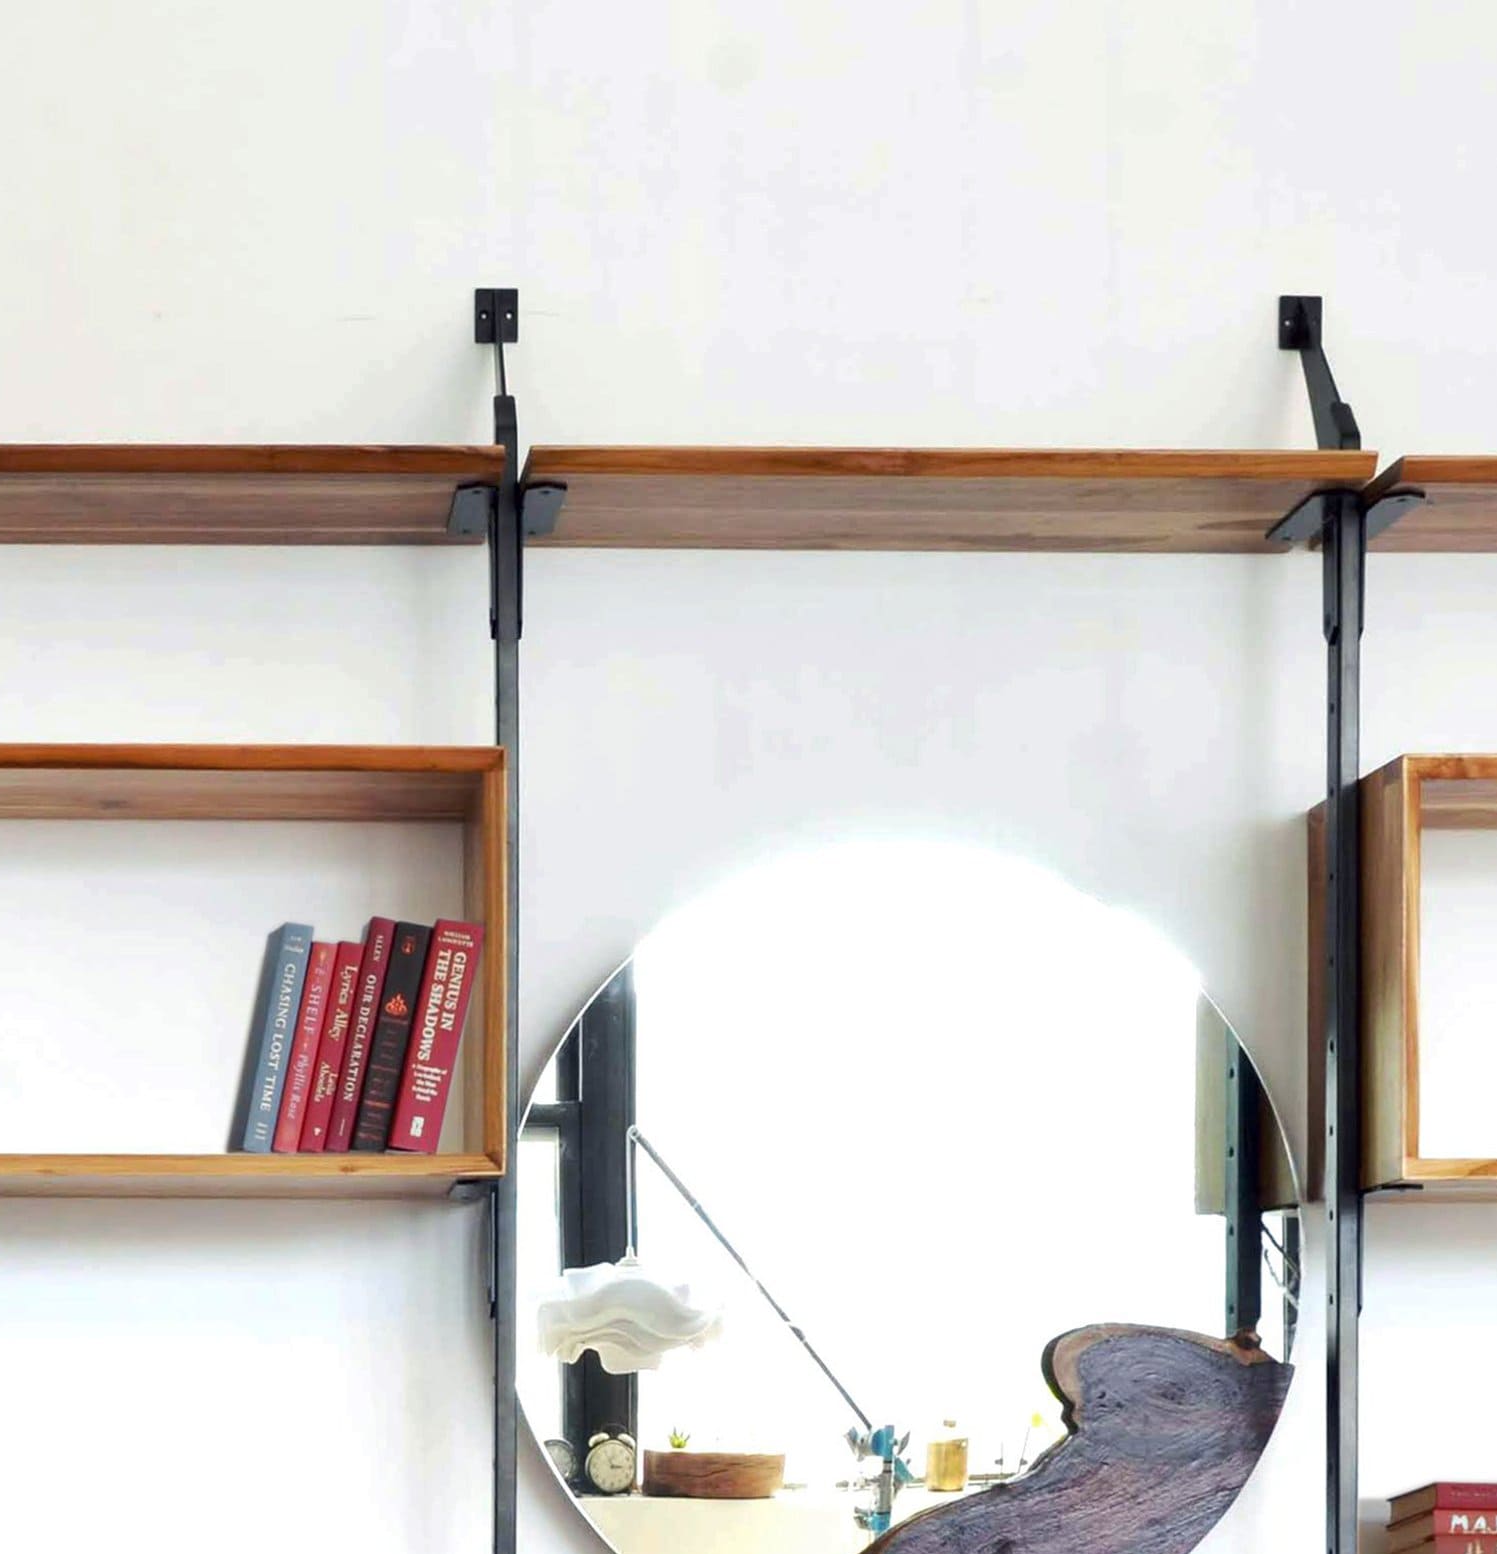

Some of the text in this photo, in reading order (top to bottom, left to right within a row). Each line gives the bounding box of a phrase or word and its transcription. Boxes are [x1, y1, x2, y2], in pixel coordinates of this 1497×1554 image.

[361, 974, 377, 1002] OUR
[433, 949, 451, 981] THE
[446, 951, 466, 1010] GENIUS
[274, 963, 296, 1029] CHASING
[303, 984, 322, 1034] SHELF
[328, 964, 358, 1041] Lyrics Alley
[440, 1011, 454, 1030] IN
[417, 983, 444, 1060] SHADOWS
[267, 1032, 284, 1070] LOST
[342, 1006, 370, 1101] DECLARATION
[260, 1075, 276, 1111] TIME
